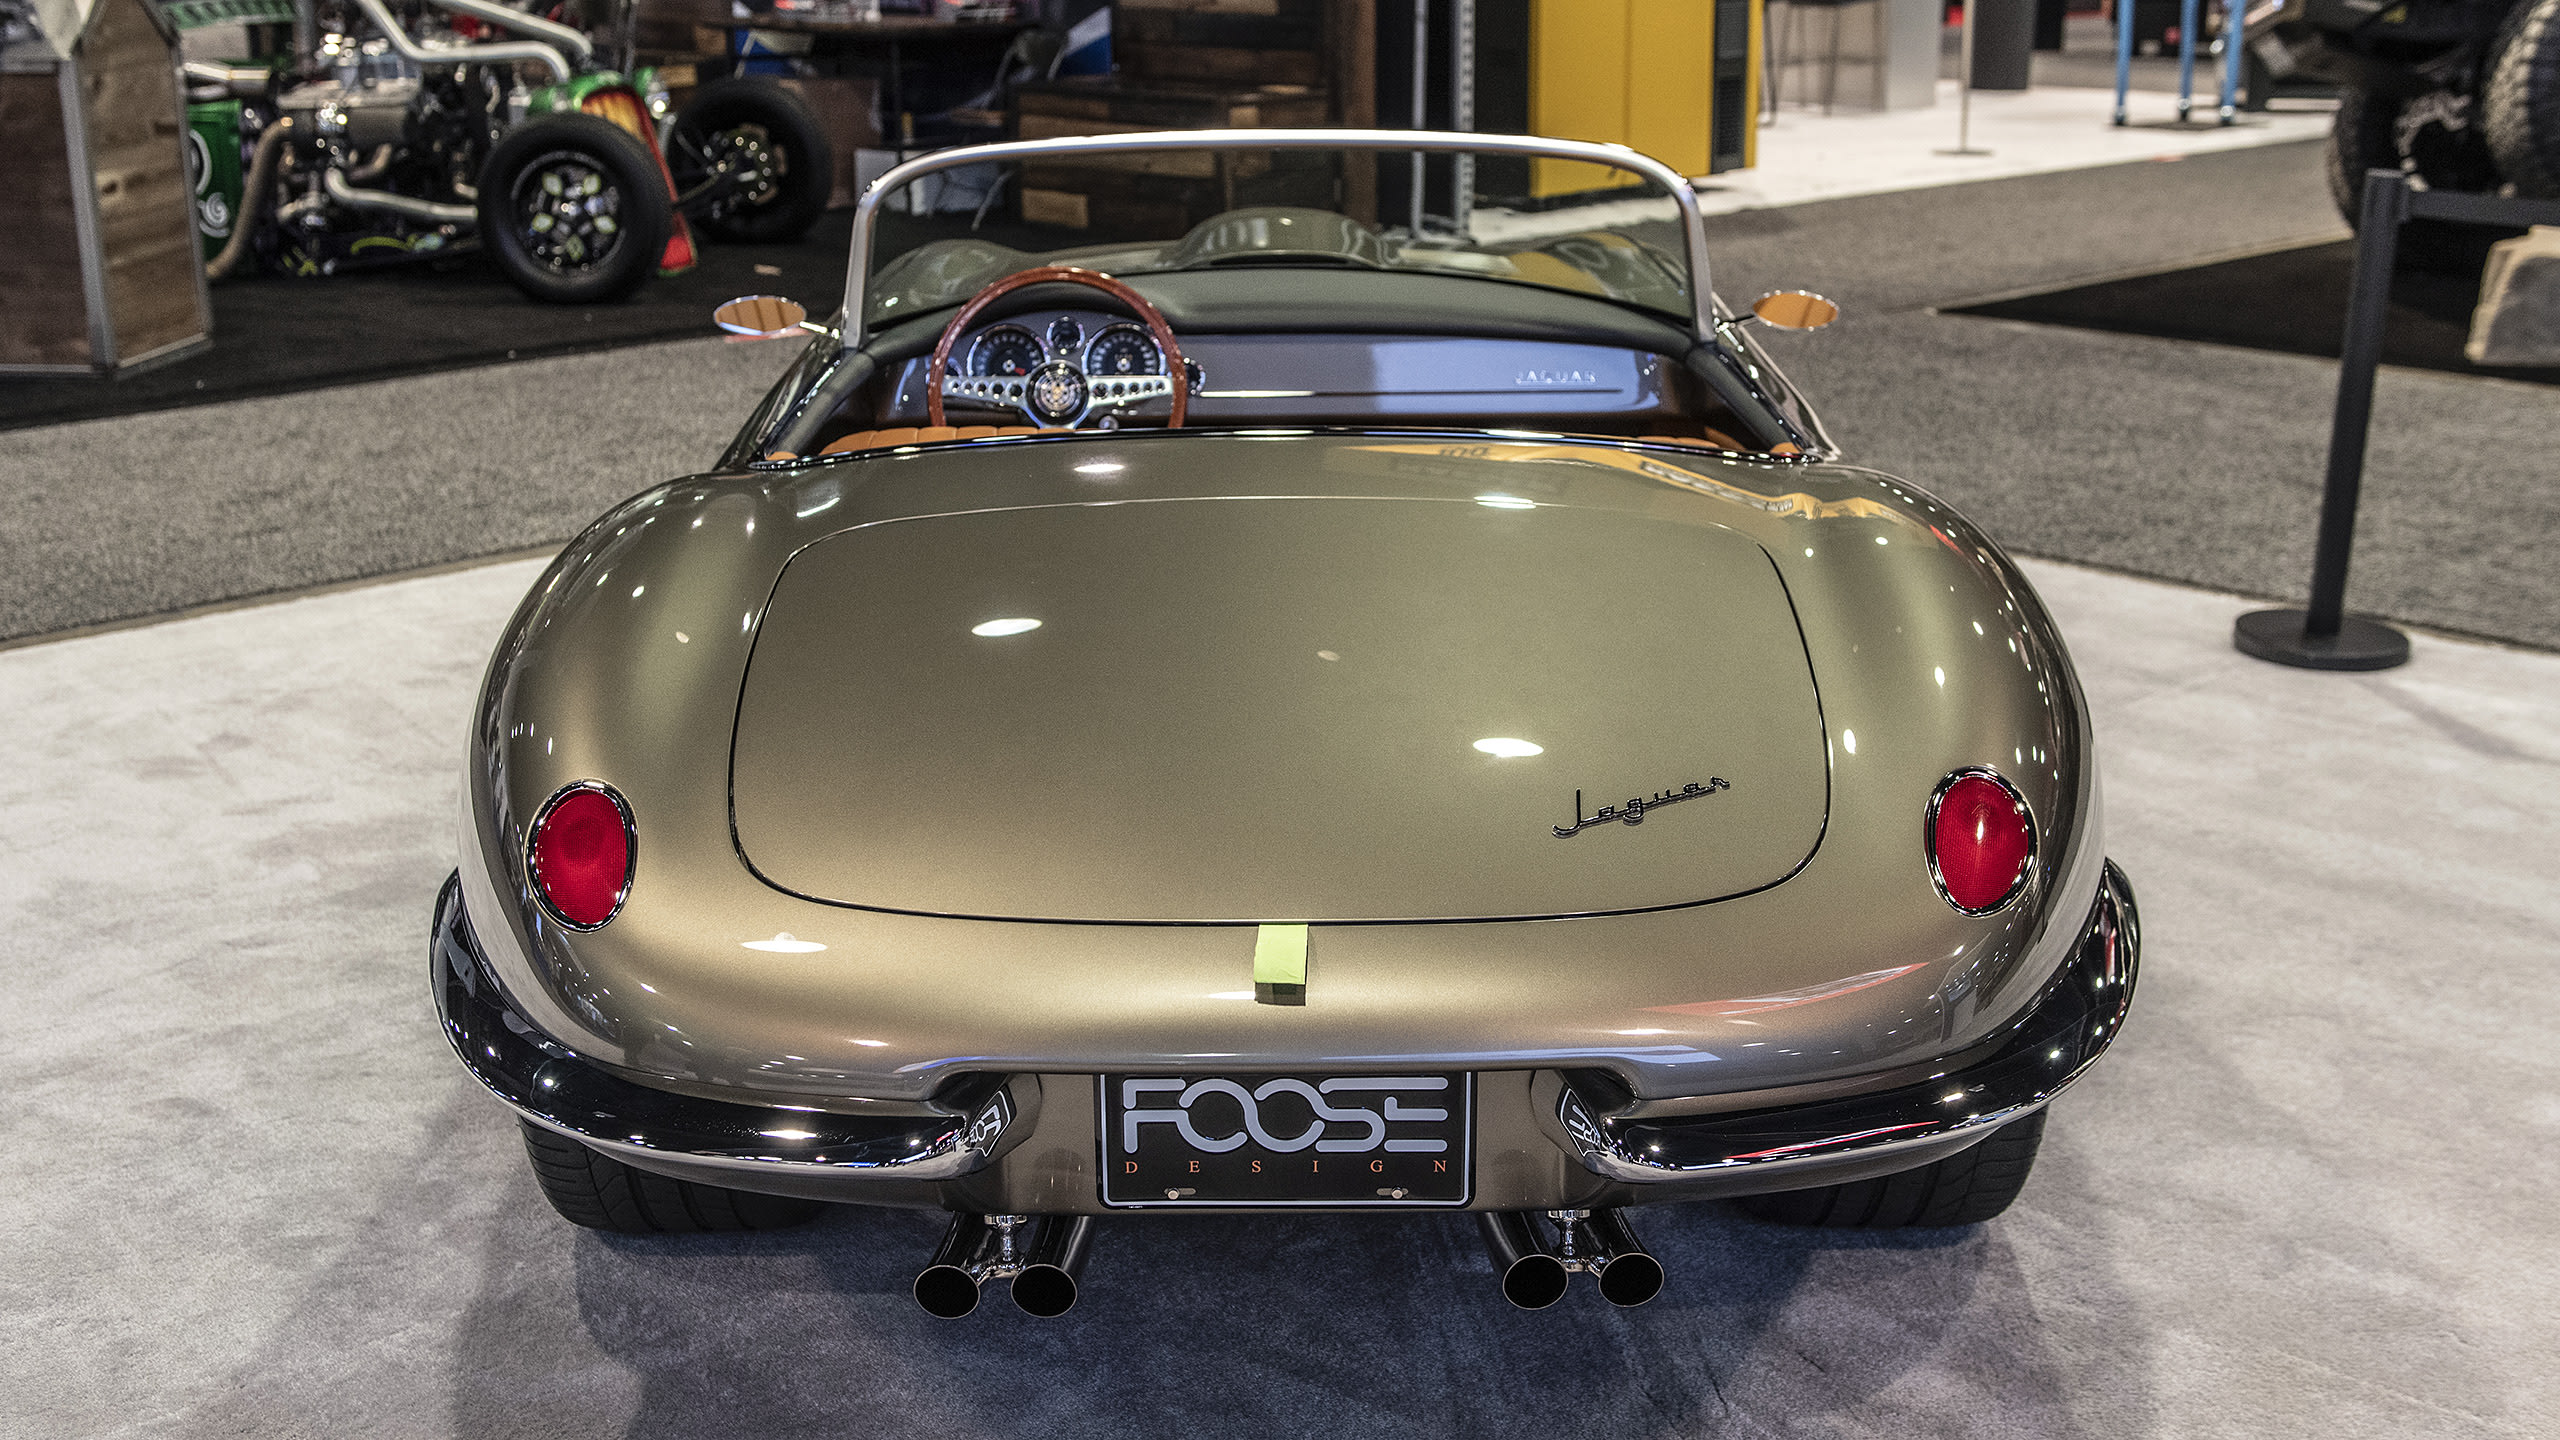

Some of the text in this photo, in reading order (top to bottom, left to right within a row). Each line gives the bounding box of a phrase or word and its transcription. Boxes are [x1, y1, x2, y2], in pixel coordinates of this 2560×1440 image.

[1515, 370, 1597, 384] JAGUAR
[1552, 776, 1730, 839] Jaguar
[1123, 1077, 1449, 1154] FOOSE
[1125, 1160, 1447, 1174] DESIGN
